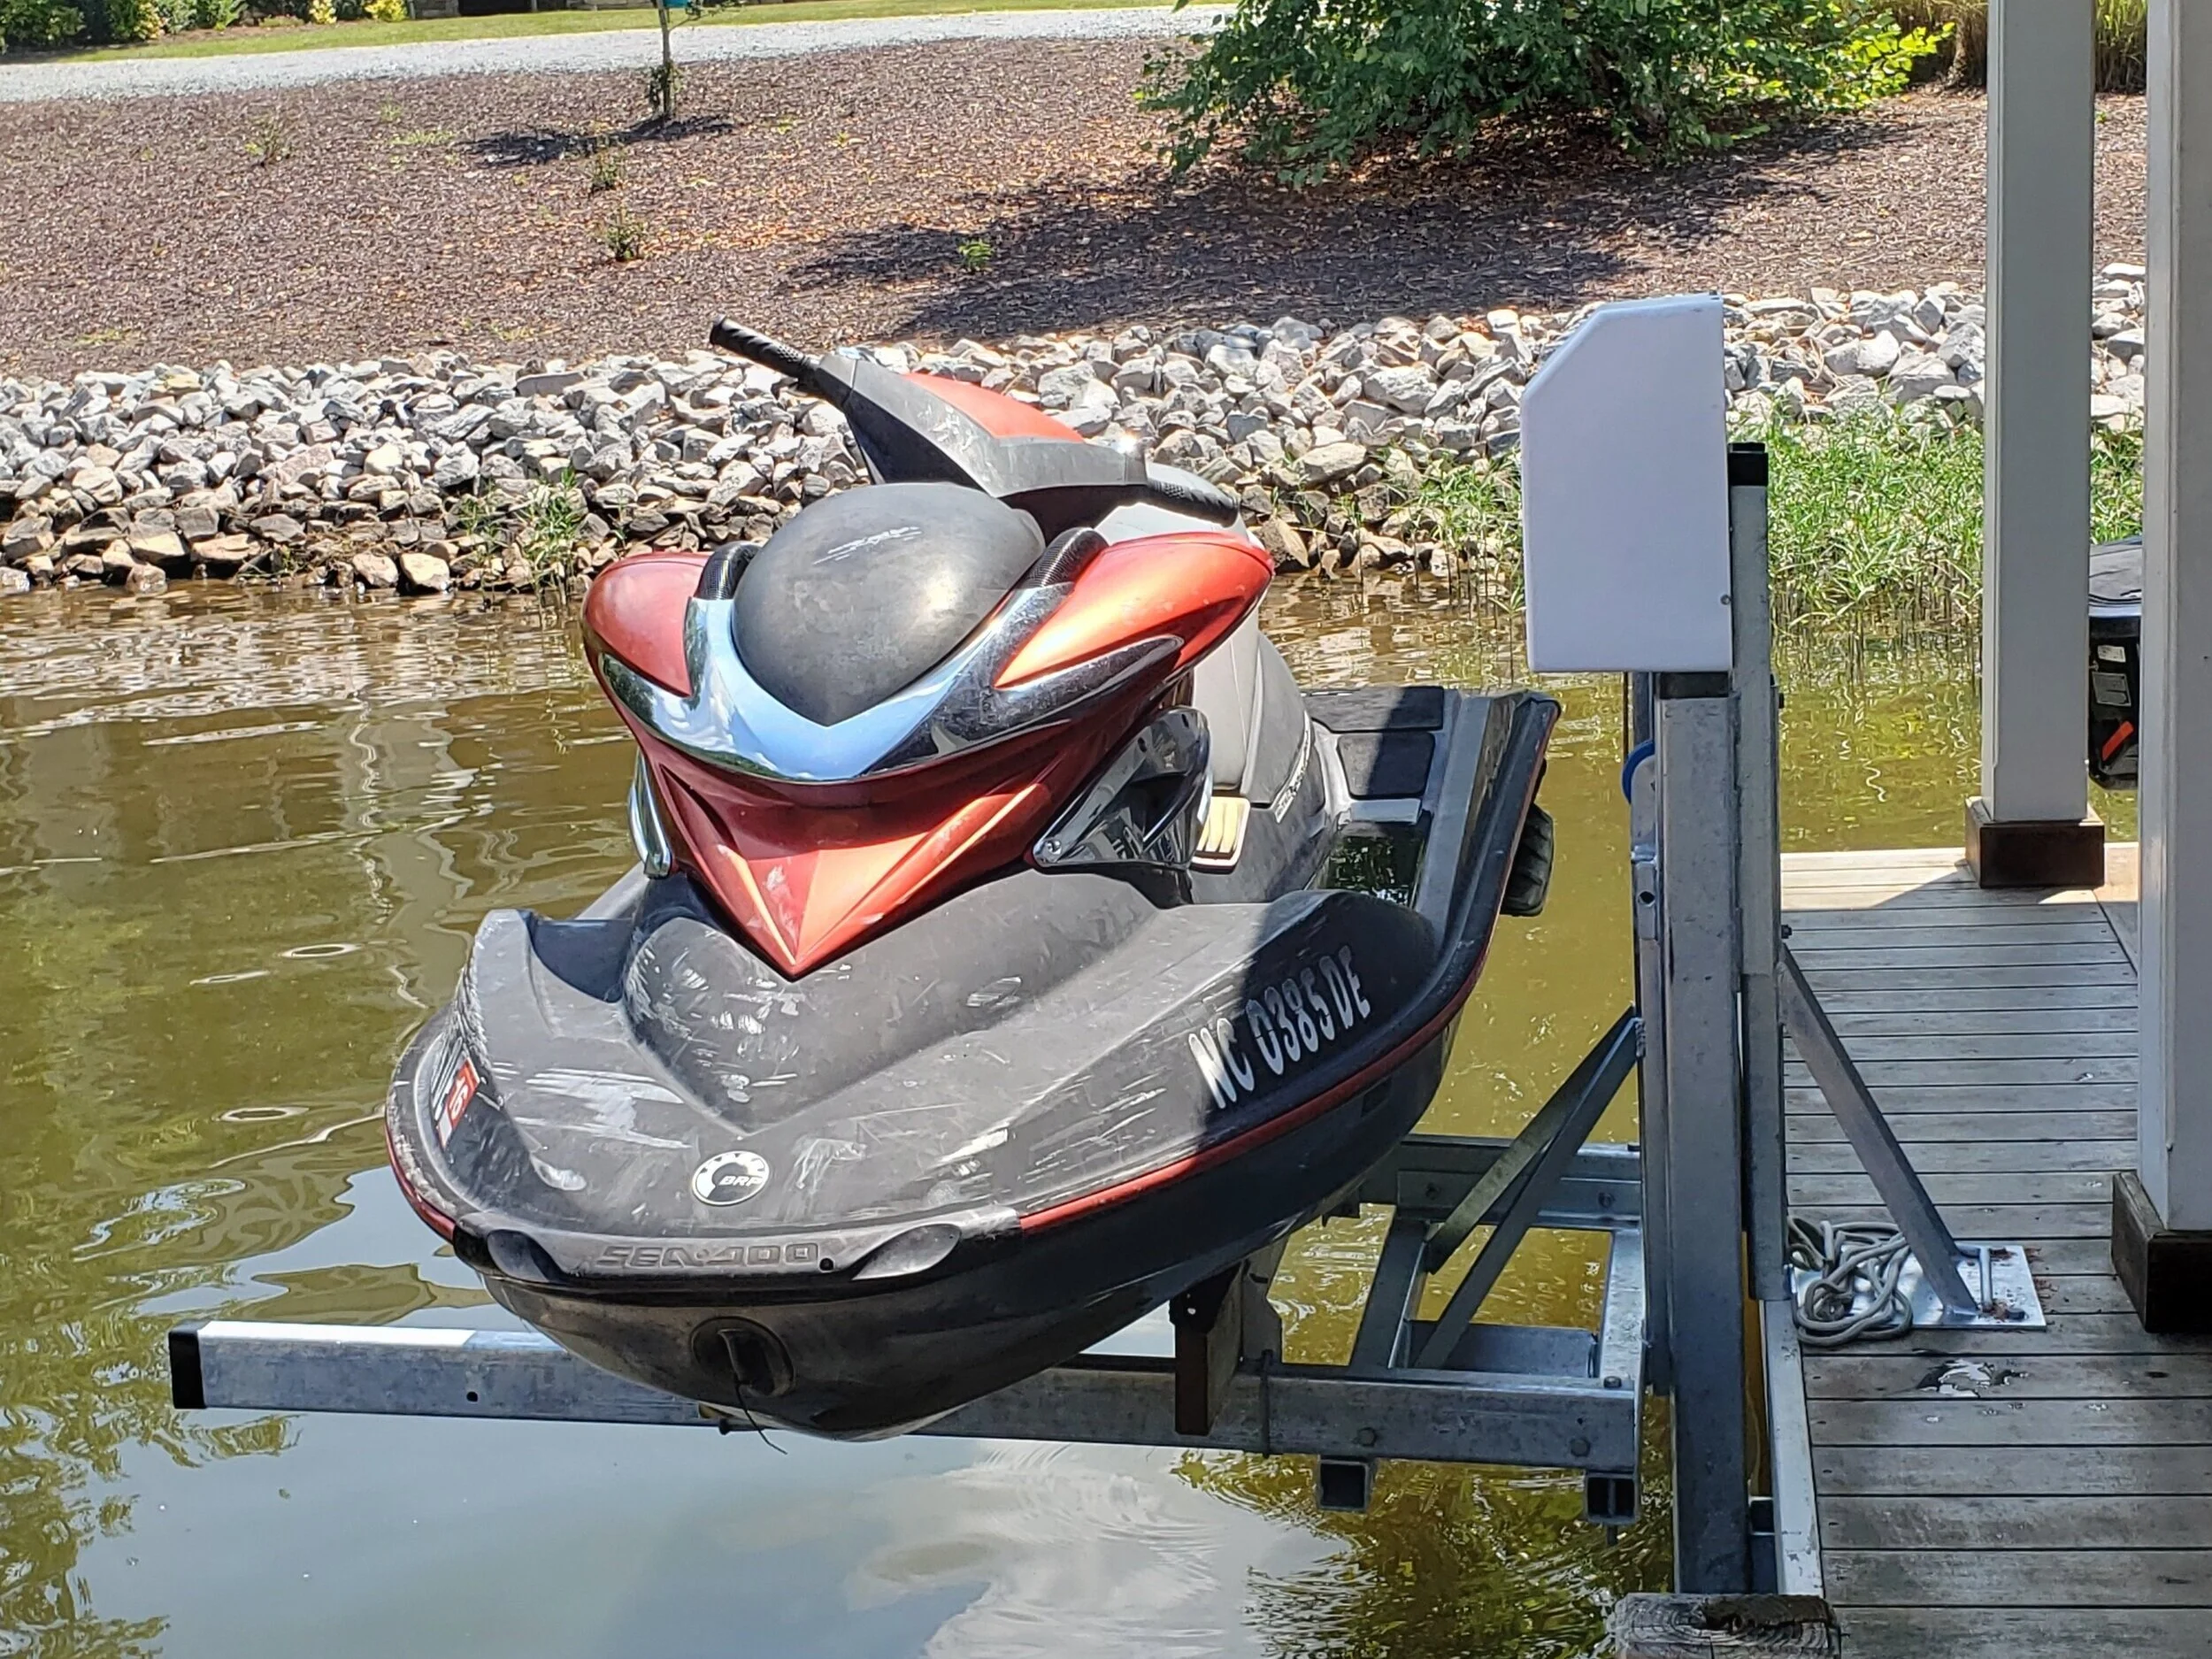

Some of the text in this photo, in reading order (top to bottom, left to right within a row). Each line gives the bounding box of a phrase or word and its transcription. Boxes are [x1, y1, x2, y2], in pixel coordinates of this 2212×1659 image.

[1188, 945, 1371, 1109] NC 0385 DE
[718, 1175, 764, 1187] BRP
